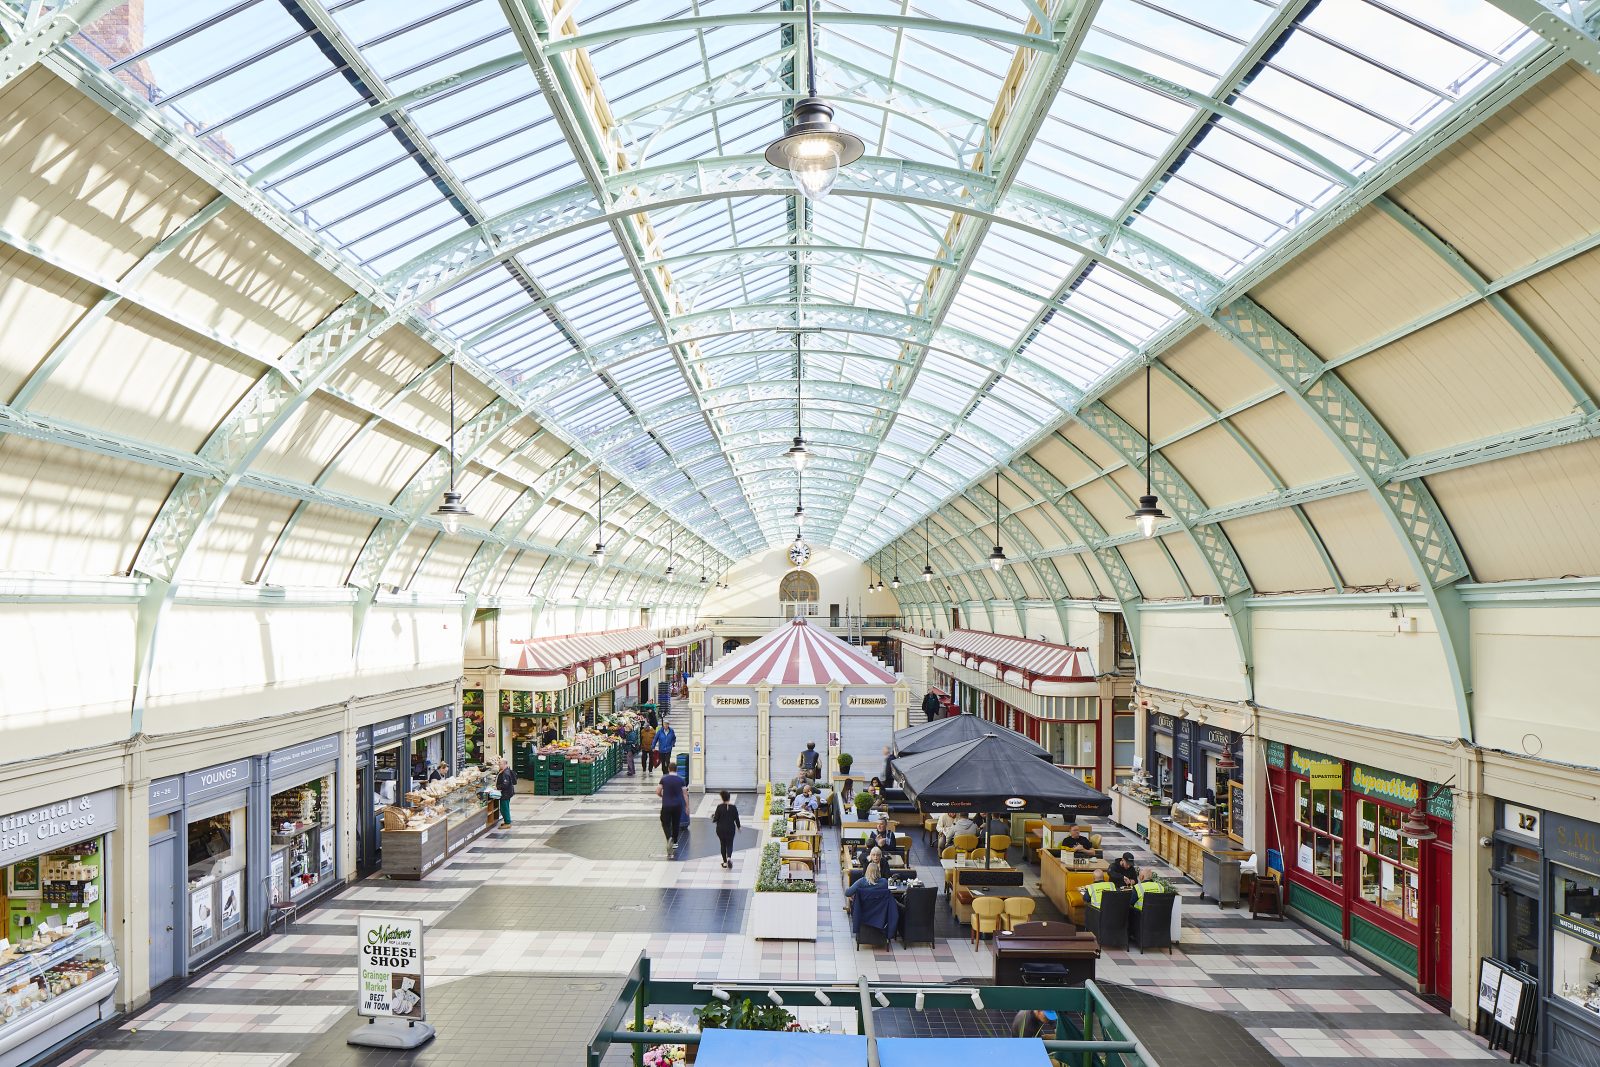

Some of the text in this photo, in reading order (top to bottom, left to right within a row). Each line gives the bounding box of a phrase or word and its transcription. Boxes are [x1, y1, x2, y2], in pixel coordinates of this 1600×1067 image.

[782, 698, 820, 706] COSMETICS
[201, 767, 237, 787] YOUNGS
[1353, 767, 1419, 804] Supastitch
[79, 796, 92, 811] &
[37, 813, 95, 839] Cheese
[1518, 812, 1537, 832] 17
[1560, 919, 1574, 931] WATCH
[1573, 924, 1595, 939] BATTERIES
[363, 944, 417, 958] CHEESE
[370, 956, 410, 968] SHOP
[362, 969, 390, 982] Grainger
[365, 981, 387, 992] Market
[369, 993, 384, 1002] BEST
[364, 1001, 390, 1011] IN TOON
